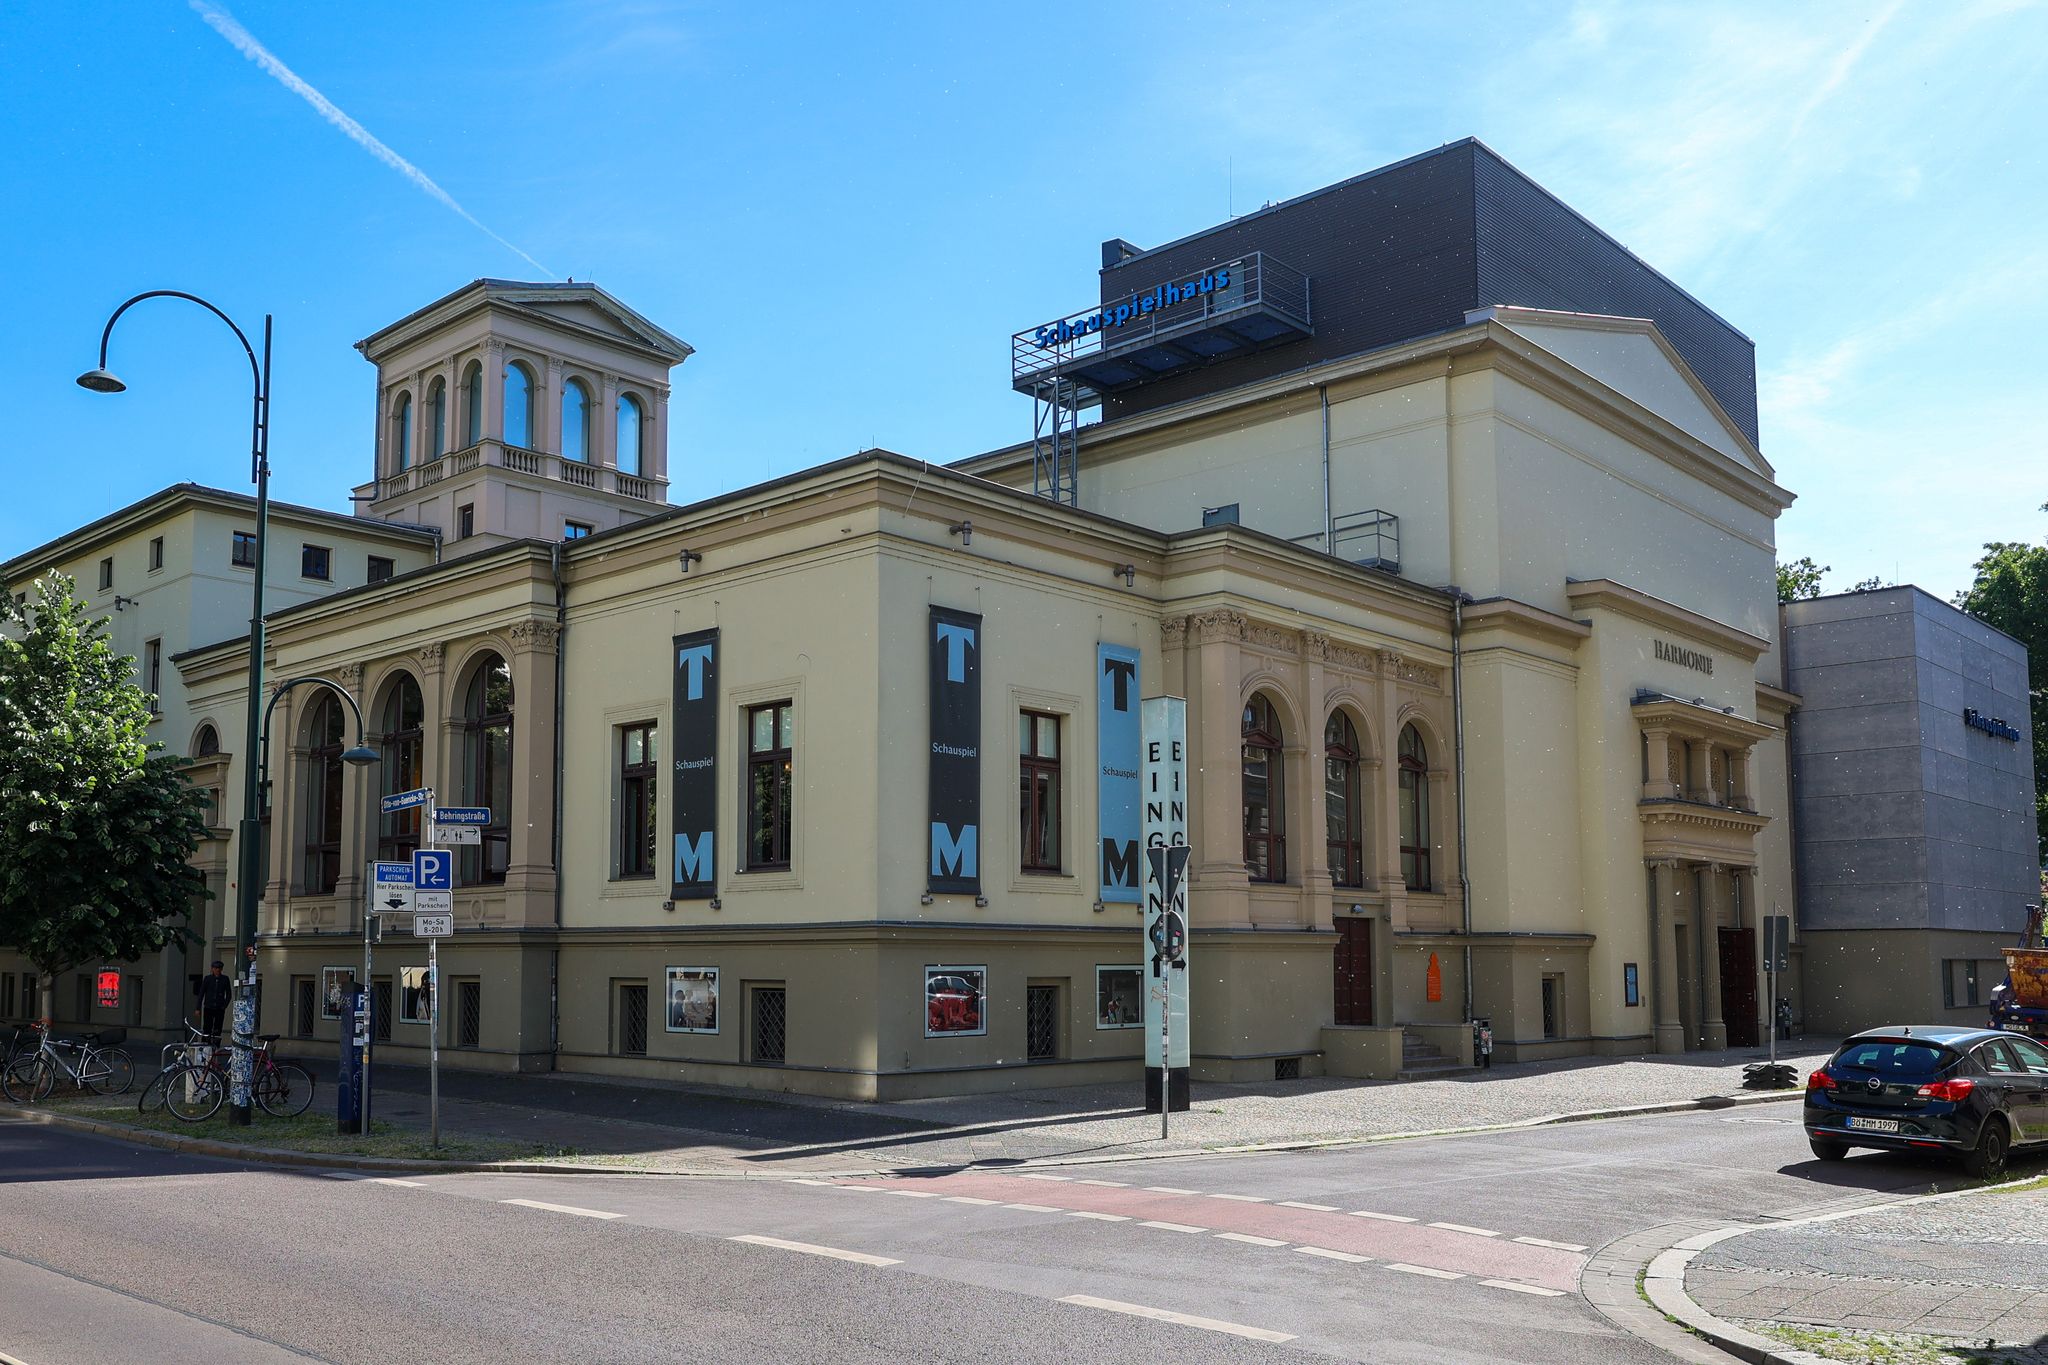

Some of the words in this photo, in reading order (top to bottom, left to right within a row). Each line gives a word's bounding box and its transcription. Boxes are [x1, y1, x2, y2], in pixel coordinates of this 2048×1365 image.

[1034, 271, 1230, 349] Schauspielhaus
[680, 644, 712, 700] T
[937, 623, 974, 683] T
[1654, 639, 1713, 675] HARMONIE
[1105, 659, 1135, 712] T
[675, 756, 713, 770] Schauspiel
[932, 742, 977, 758] Schauspiel
[1102, 766, 1138, 779] Schauspiel
[440, 811, 486, 822] Behringstraße
[675, 832, 713, 882] M
[932, 822, 976, 878] M
[1103, 838, 1138, 887] M
[1147, 741, 1164, 943] EINGN
[379, 865, 413, 873] PARKSCHEIN-
[420, 856, 440, 885] P
[423, 918, 444, 926] Mo-Sa
